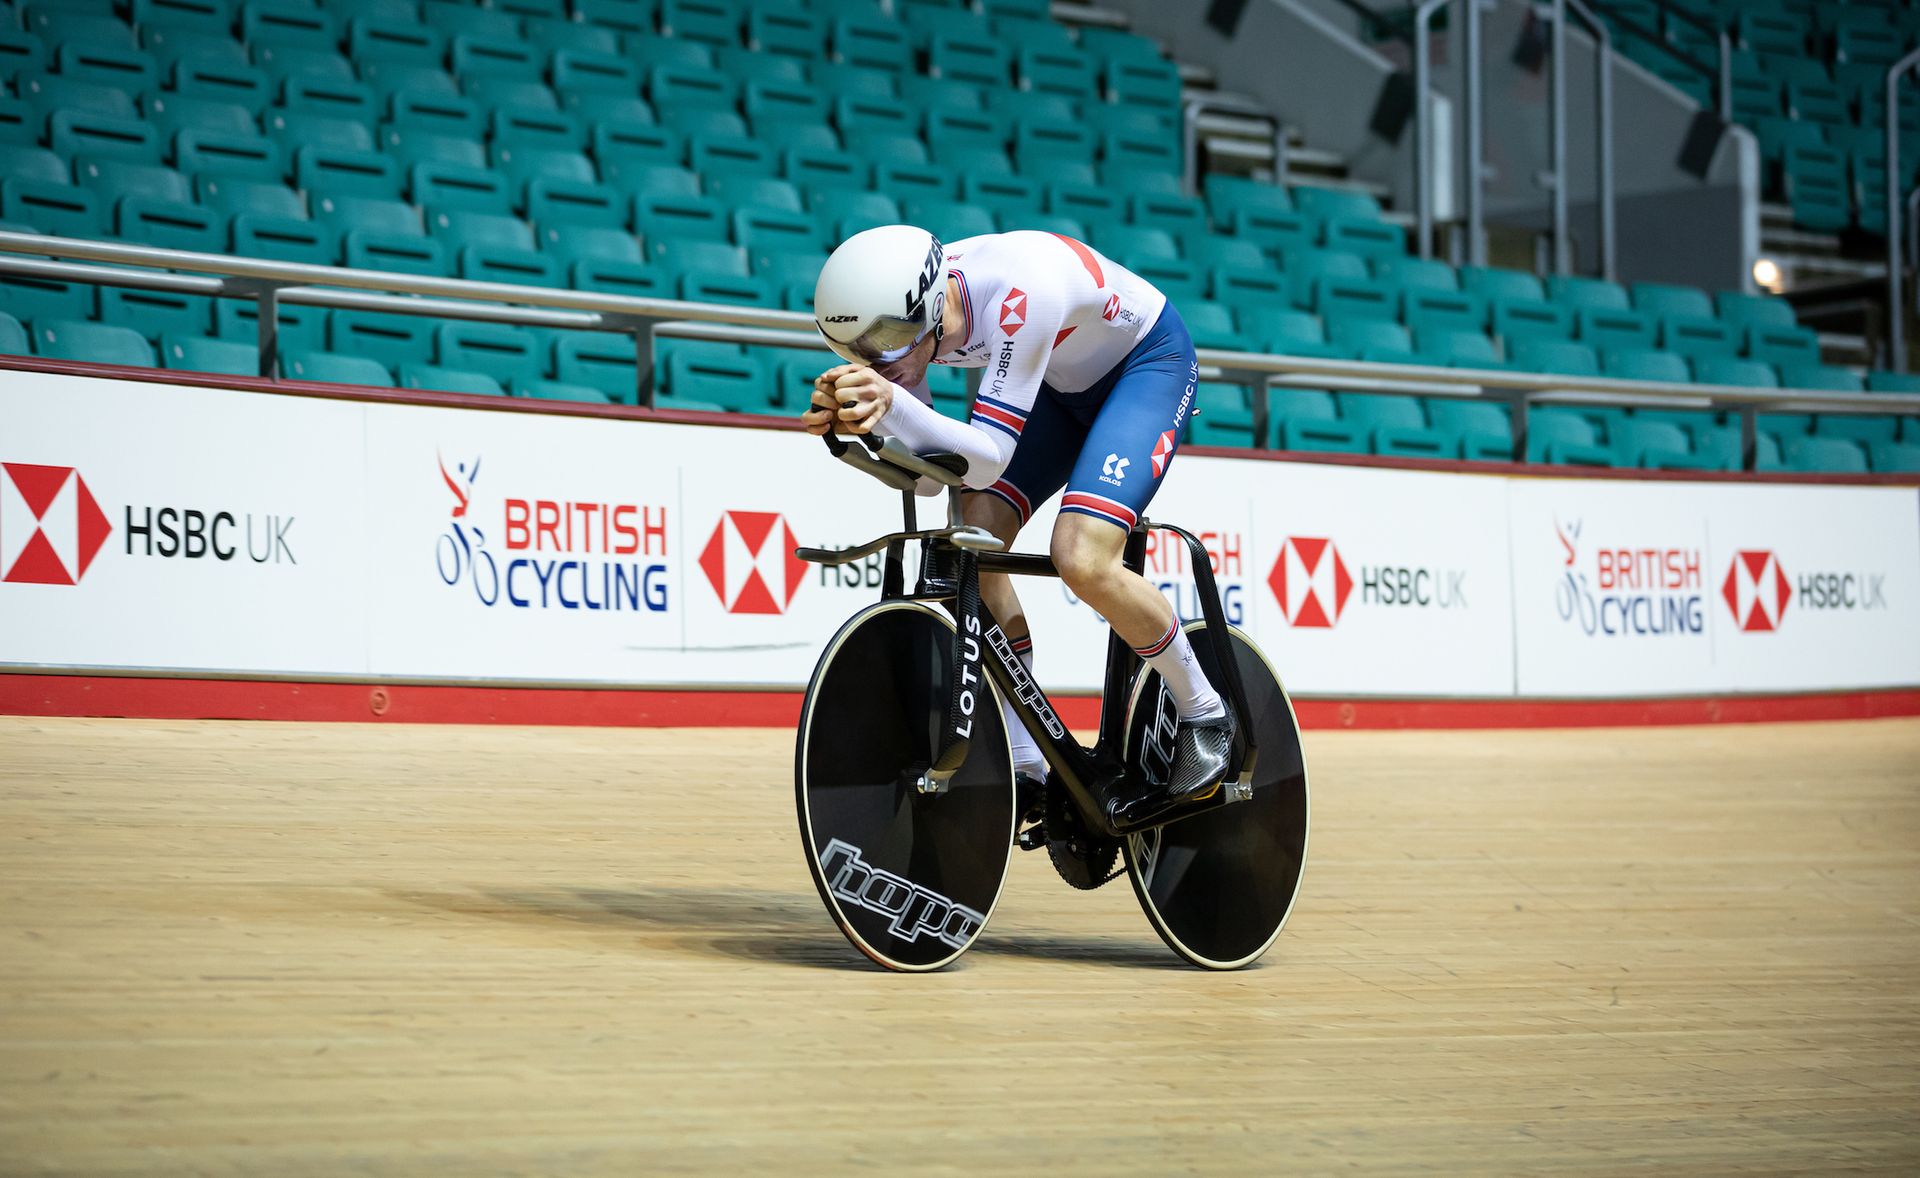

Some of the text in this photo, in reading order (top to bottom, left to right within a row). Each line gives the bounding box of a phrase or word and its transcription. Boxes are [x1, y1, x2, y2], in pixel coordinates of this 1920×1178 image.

[905, 234, 943, 316] LAZER
[824, 315, 859, 323] LAZER
[989, 341, 1015, 397] HSBC UK
[1173, 360, 1198, 428] HSBC UK
[126, 505, 297, 564] HSBC UK
[505, 498, 667, 556] BRITISH
[506, 559, 667, 611] CYCLING
[819, 544, 884, 588] HSB
[1362, 566, 1469, 608] HSBC UK
[1598, 549, 1702, 589] BRITISH
[1798, 573, 1889, 610] HSBC UK
[1600, 596, 1704, 635] CYCLING
[956, 614, 981, 739] LOTUS
